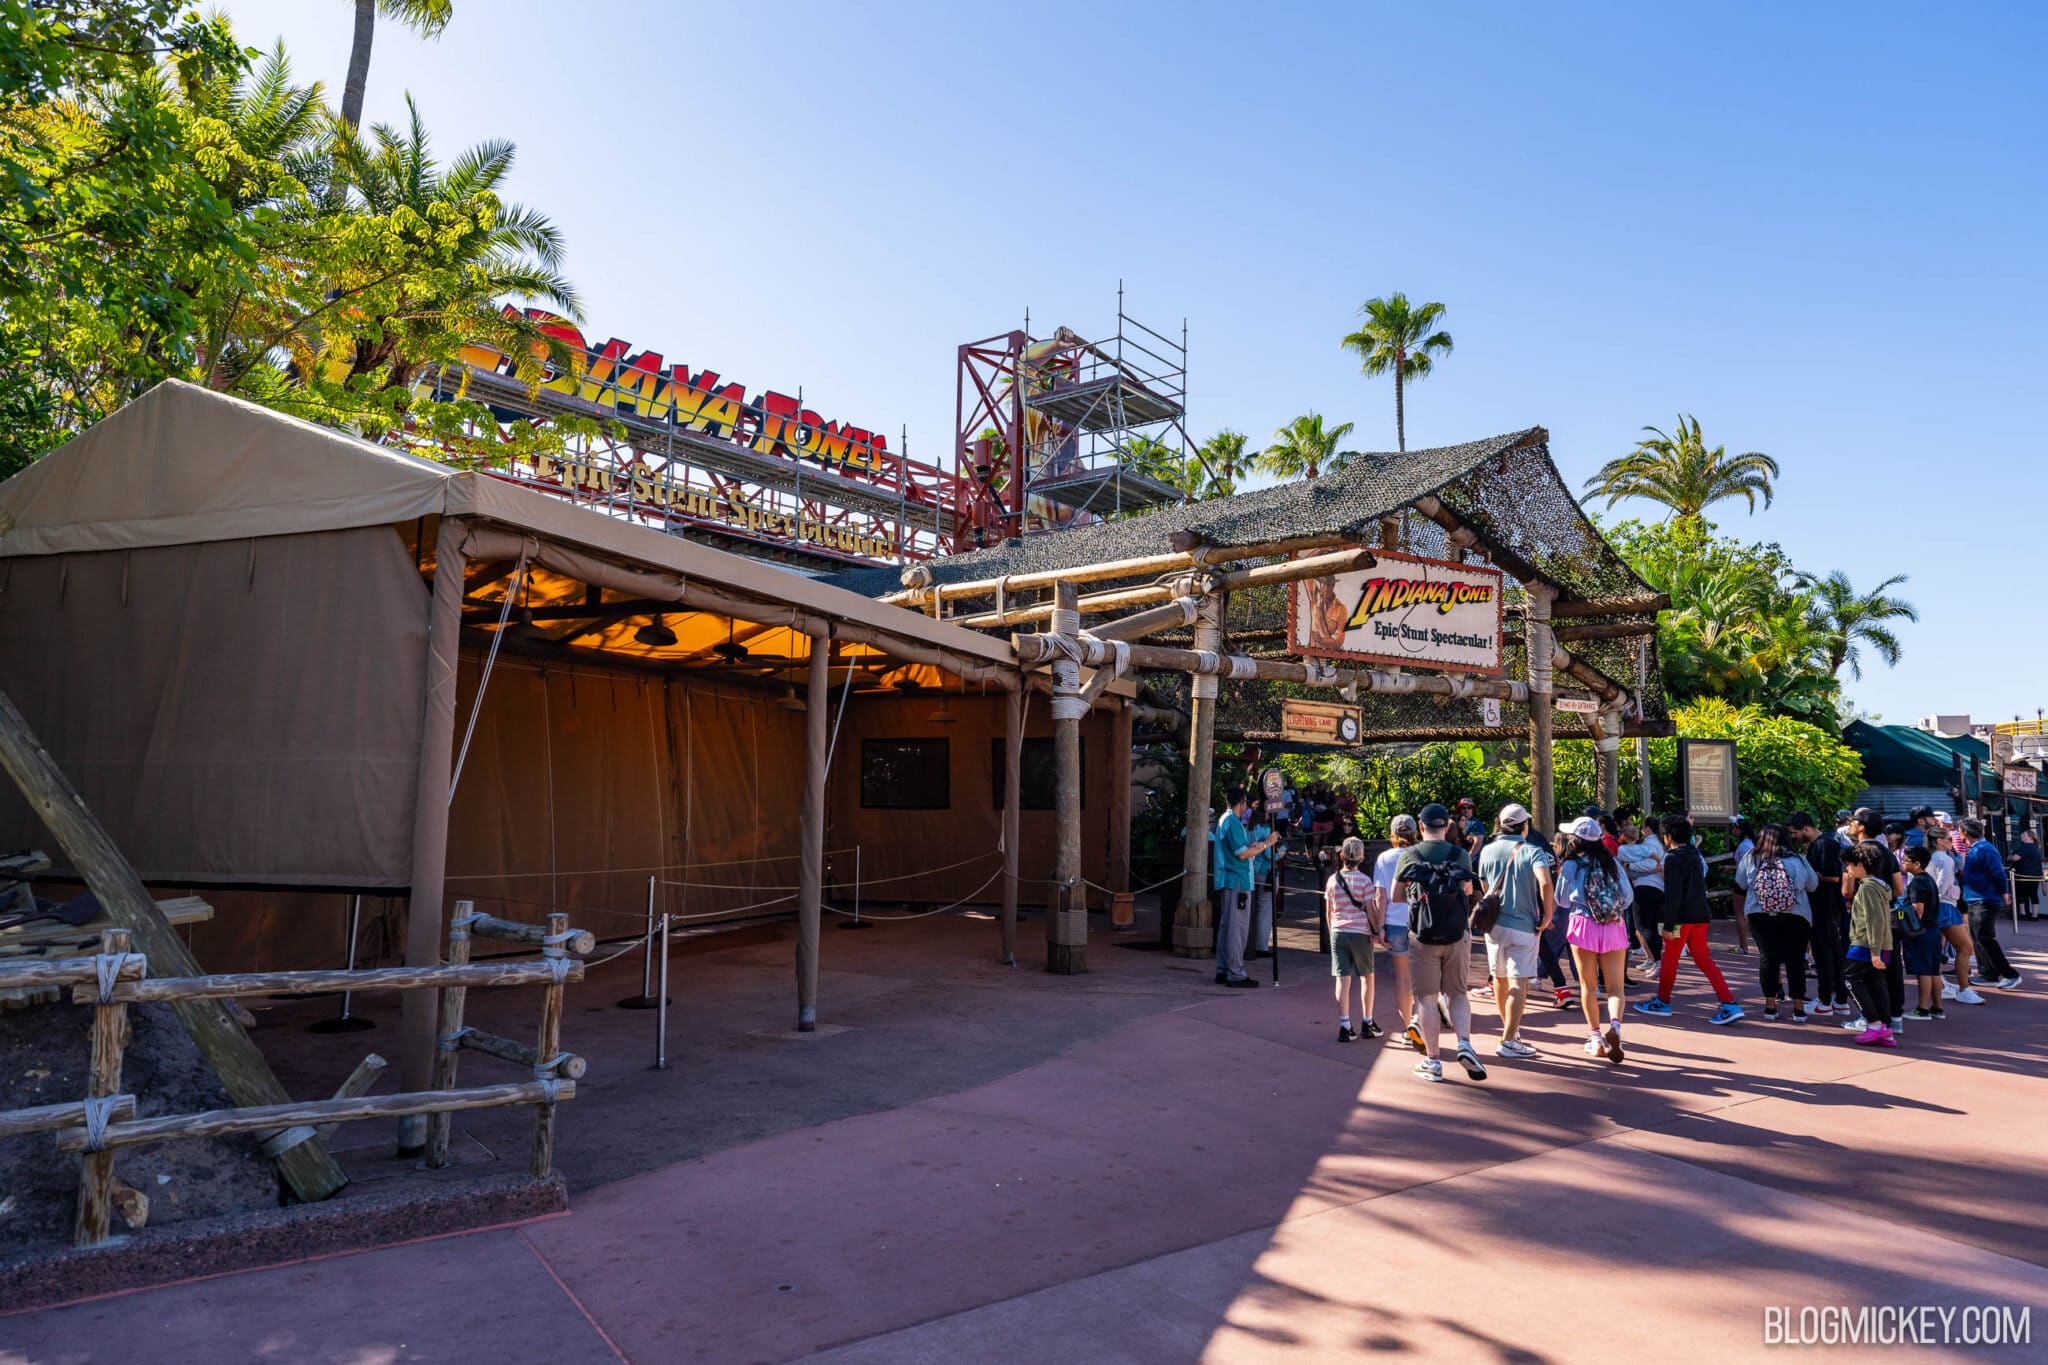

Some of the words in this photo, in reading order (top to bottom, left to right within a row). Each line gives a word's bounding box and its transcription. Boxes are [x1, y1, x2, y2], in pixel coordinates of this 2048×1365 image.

[752, 390, 887, 474] JONES
[535, 448, 620, 492] Epic
[632, 463, 719, 518] Stunt
[1345, 577, 1448, 630] INDIANA
[1437, 581, 1494, 615] JONES
[1374, 621, 1399, 640] Epic
[1401, 623, 1429, 642] Stunt
